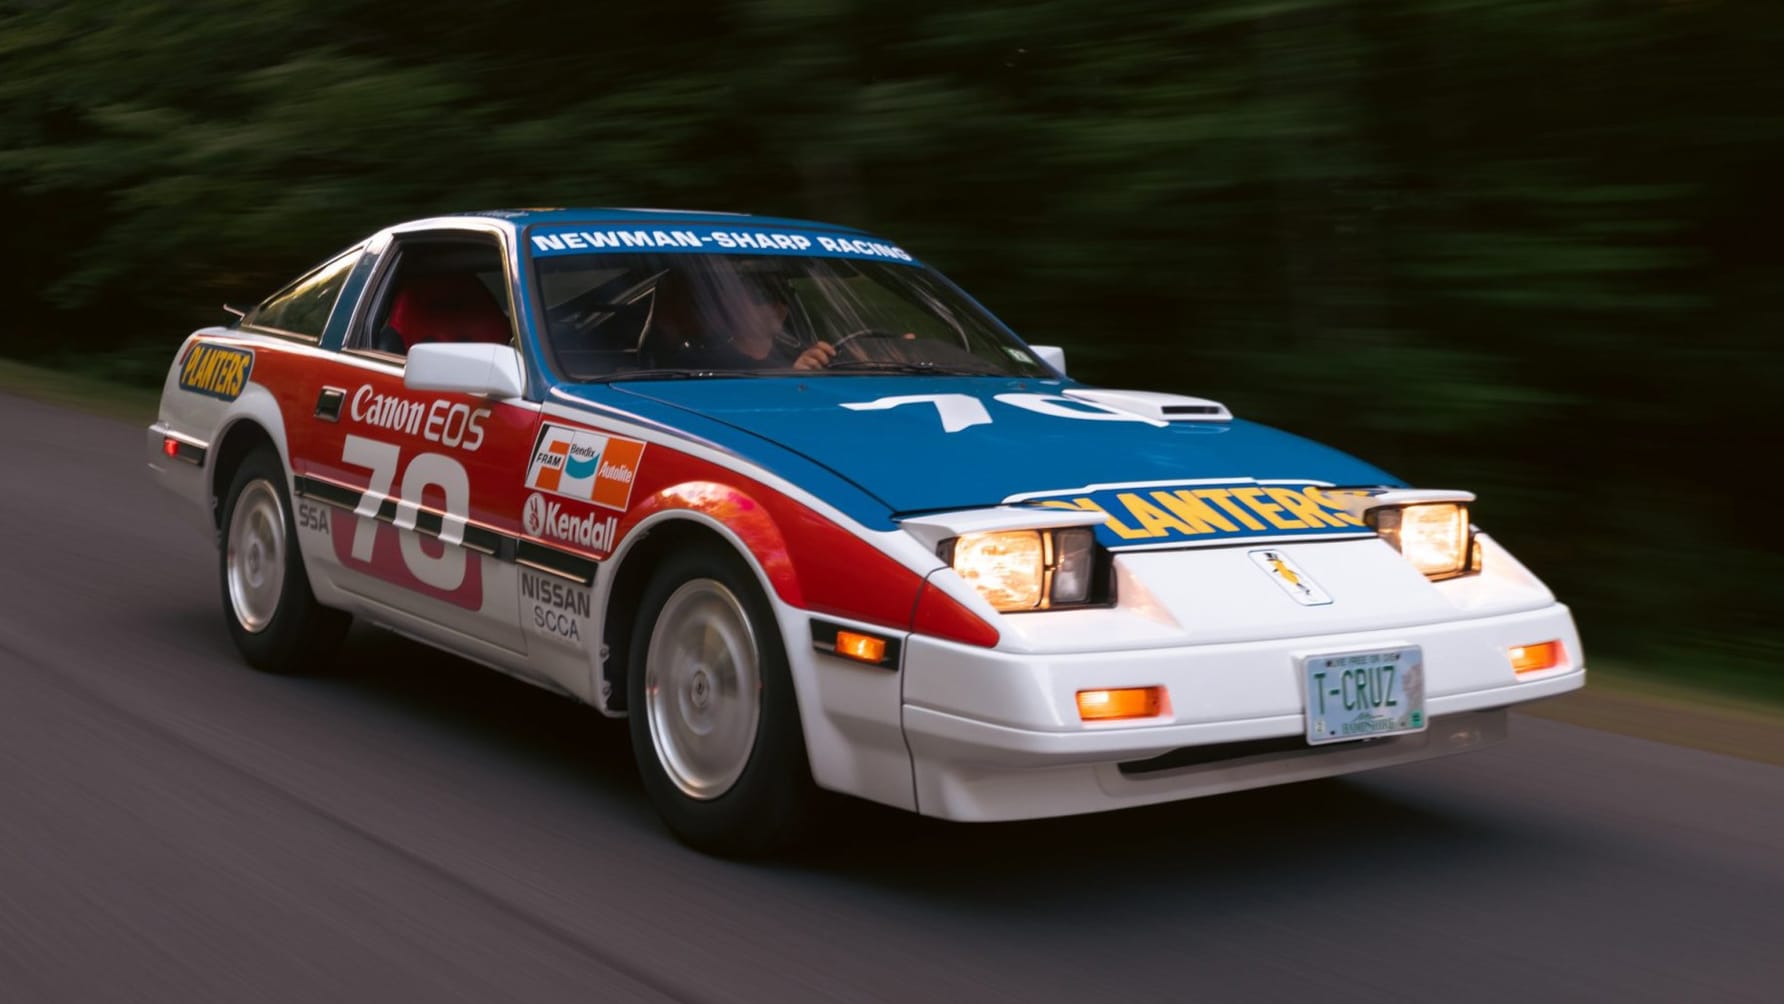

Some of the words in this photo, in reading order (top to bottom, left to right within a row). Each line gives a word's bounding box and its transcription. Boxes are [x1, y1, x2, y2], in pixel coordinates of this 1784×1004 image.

[531, 230, 811, 251] NEWMAN-SHARP
[816, 236, 913, 262] RACING
[181, 346, 250, 397] PLANTERS
[351, 384, 424, 435] Canon
[424, 400, 492, 451] EOS
[536, 453, 562, 466] FRAM
[570, 444, 596, 457] Bendix
[599, 461, 632, 483] Autolite
[299, 504, 330, 536] SSA
[342, 433, 470, 591] 70
[545, 501, 618, 553] Kendall
[522, 574, 591, 618] NISSAN
[534, 607, 580, 642] SCCA
[1313, 665, 1398, 715] T-CRUZ
